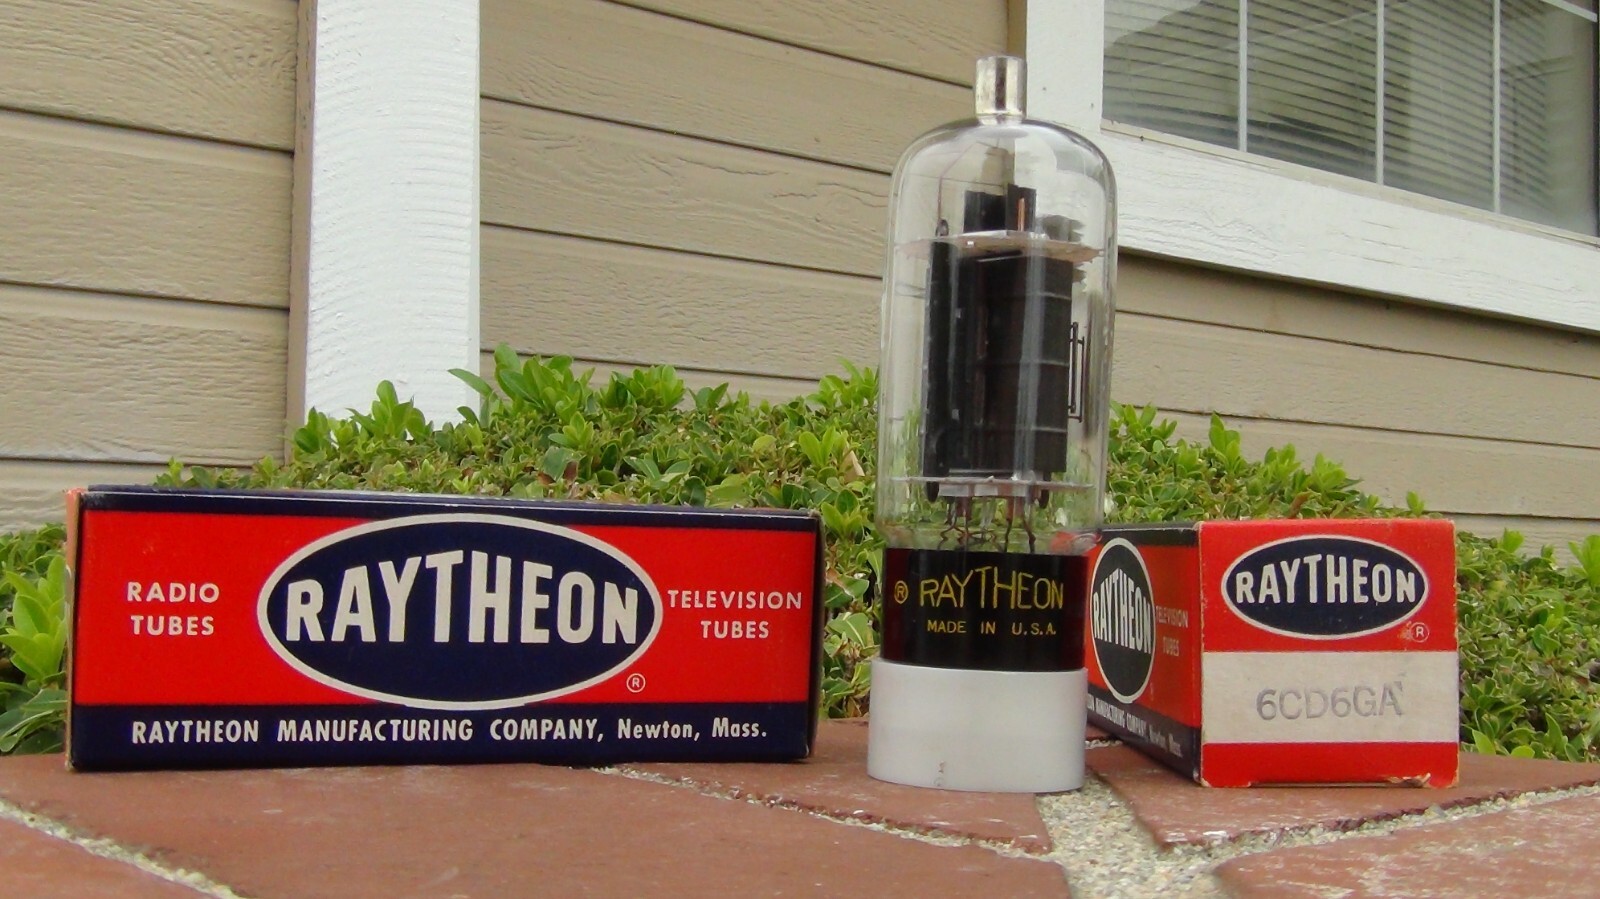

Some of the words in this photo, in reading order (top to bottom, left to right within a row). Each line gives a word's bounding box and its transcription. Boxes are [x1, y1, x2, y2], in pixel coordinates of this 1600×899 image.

[127, 582, 220, 603] RADIO
[920, 566, 1064, 609] RAYTHEON
[1235, 554, 1416, 604] RAYTHEON
[286, 550, 638, 644] RAYTHEON
[668, 589, 802, 609] TELEVISION
[1093, 568, 1152, 655] RAYTHEON
[131, 615, 214, 636] TUBES
[700, 620, 769, 639] TUBES
[927, 619, 966, 634] MADE
[981, 621, 996, 635] IN
[1012, 622, 1056, 636] U.S.A.
[1256, 681, 1403, 721] 6CD6GA
[132, 720, 259, 744] RAYTHEON
[277, 719, 473, 742] MANUFACTURING
[489, 718, 603, 743] COMPANY,
[617, 718, 700, 742] Newton,
[712, 717, 767, 738] Mass.
